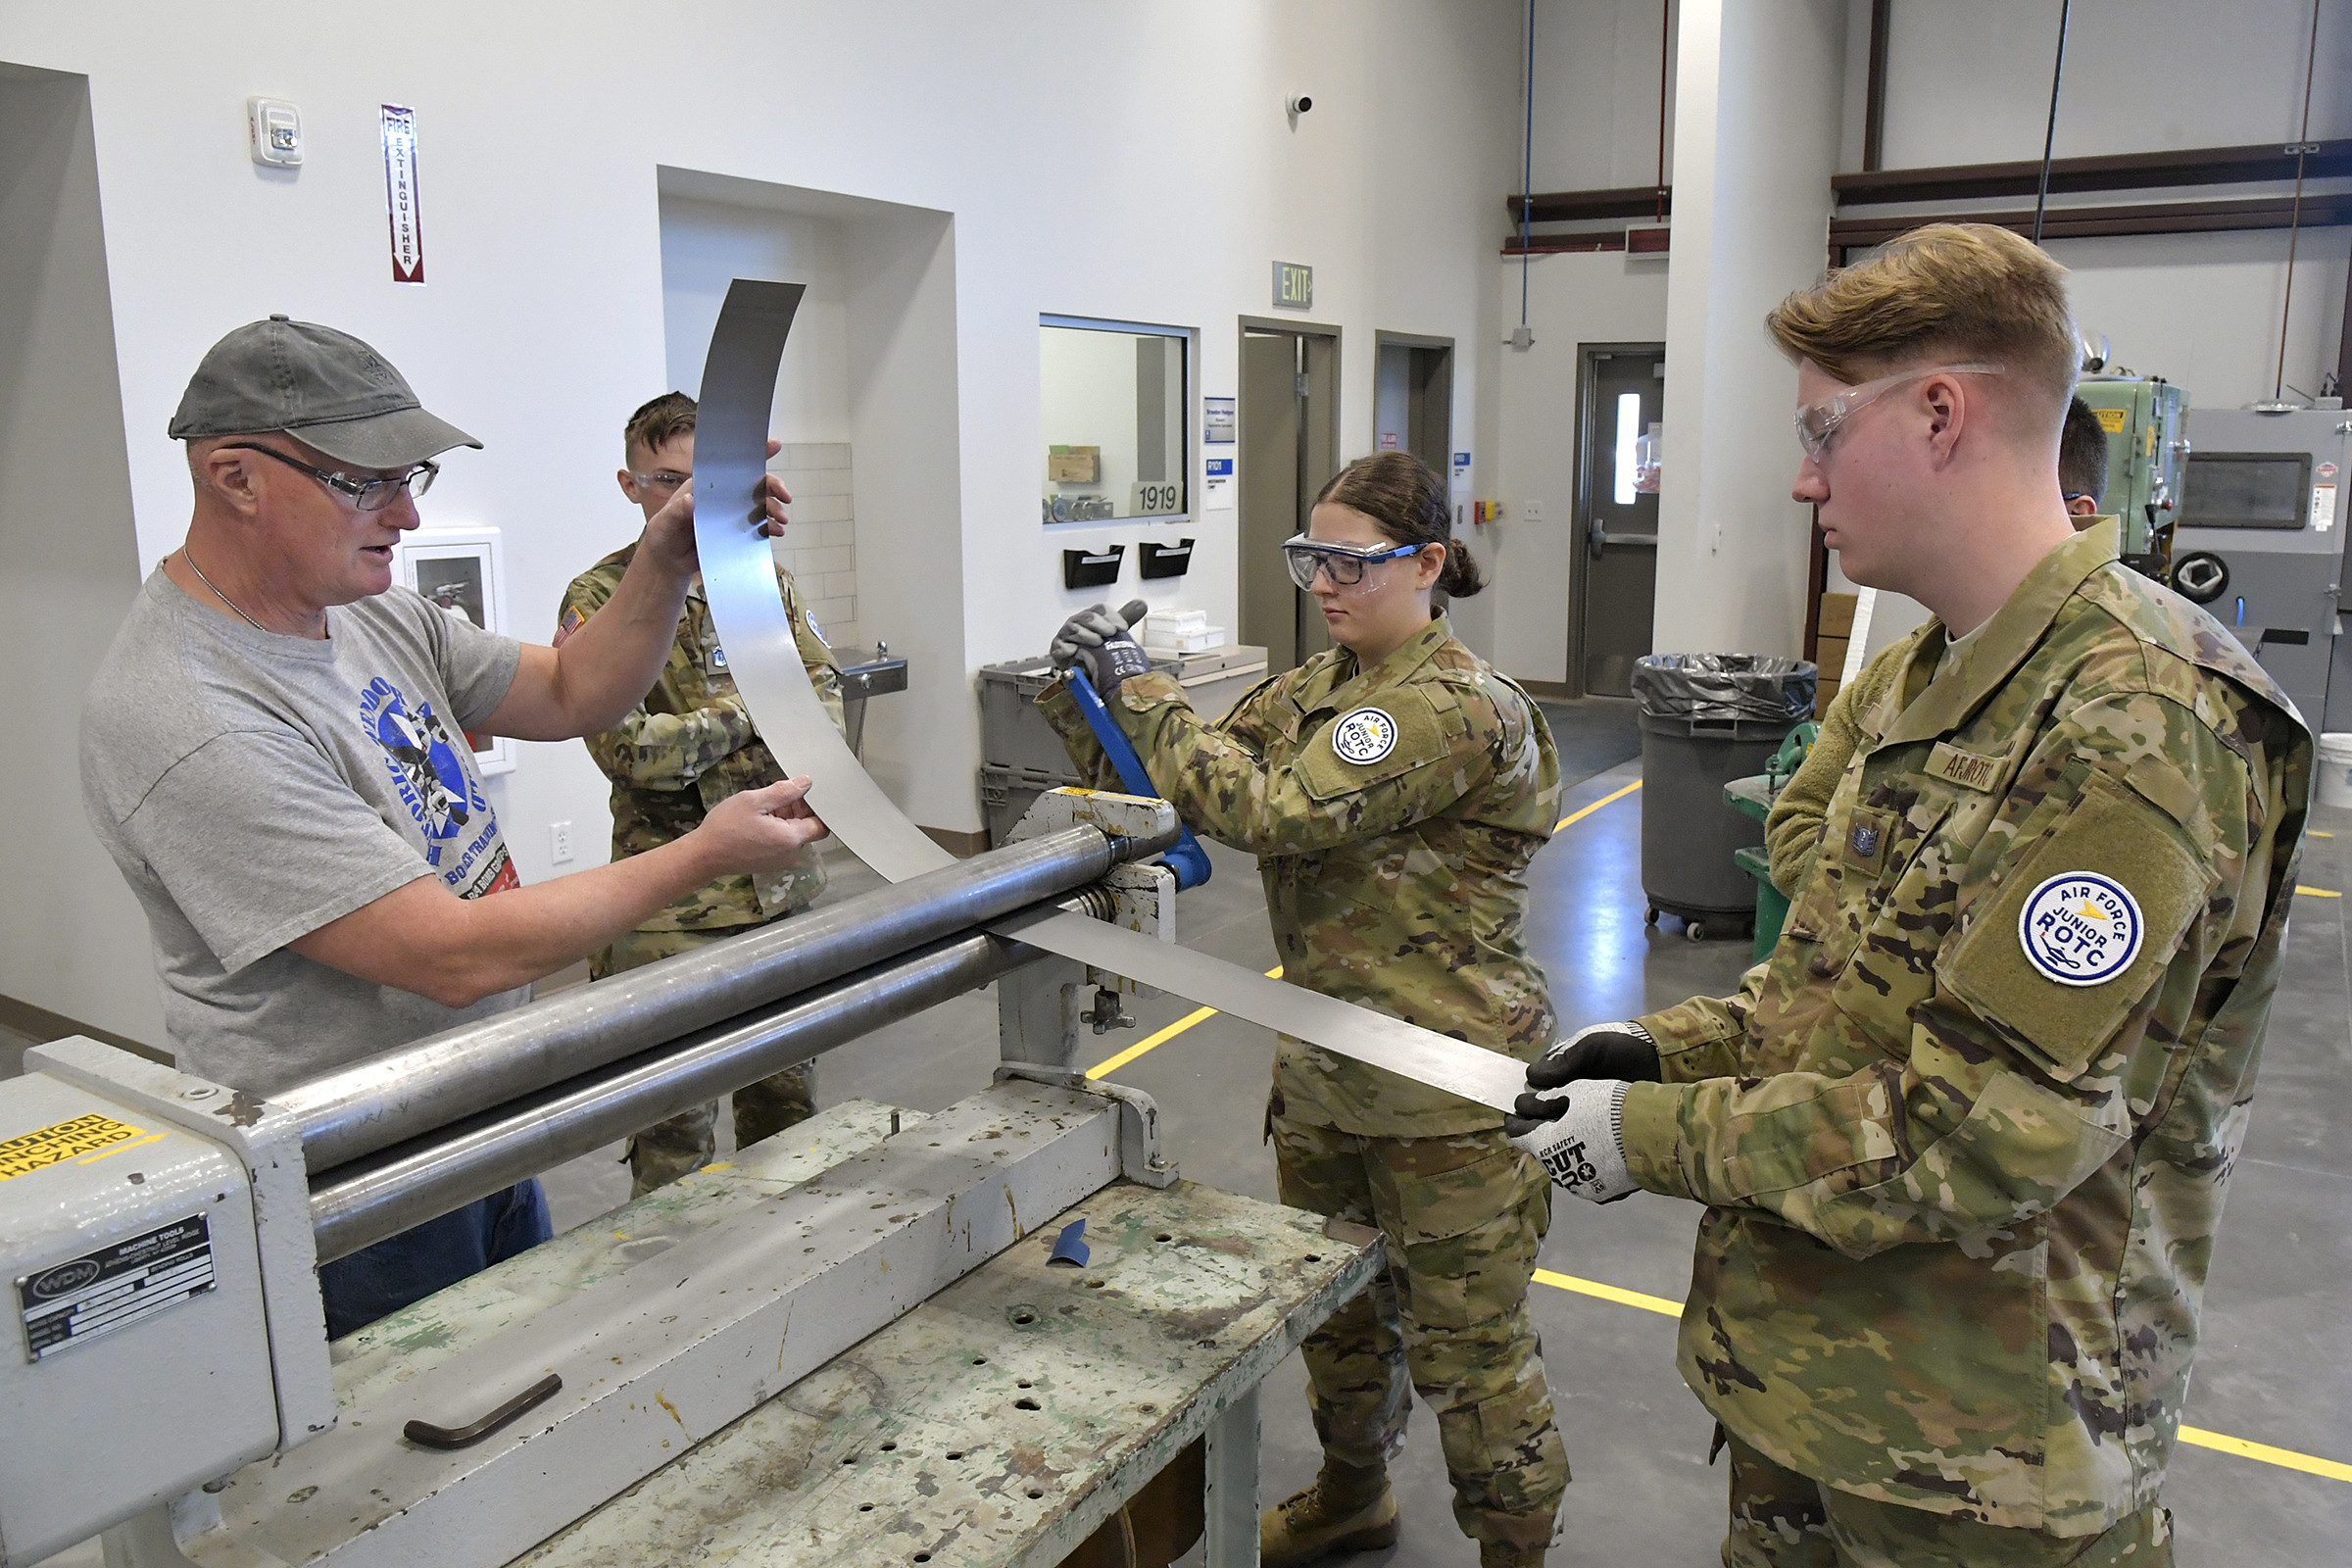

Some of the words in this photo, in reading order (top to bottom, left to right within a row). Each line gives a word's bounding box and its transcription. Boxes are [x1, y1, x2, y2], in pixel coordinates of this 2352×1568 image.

[386, 117, 411, 134] FIRE
[396, 137, 413, 265] EXTINGUISHER
[1282, 266, 1308, 302] EXIT
[1139, 486, 1176, 511] 1919
[1346, 722, 1369, 757] ROTC
[1355, 722, 1375, 749] JUNIOR
[1363, 714, 1381, 723] AIR
[1376, 722, 1390, 751] FORCE
[444, 852, 474, 885] BOER
[2052, 906, 2108, 949] JUNIOR
[2060, 886, 2090, 903] AIR
[2095, 892, 2127, 942] FORCE
[2035, 911, 2105, 967] ROTC
[1, 1130, 132, 1176] HAZARD
[1542, 1141, 1587, 1176] CUT
[1552, 1135, 1576, 1152] SAFETY
[119, 1236, 158, 1256] MACHINE
[158, 1226, 185, 1242] TOOLS
[38, 1265, 96, 1293] WDM
